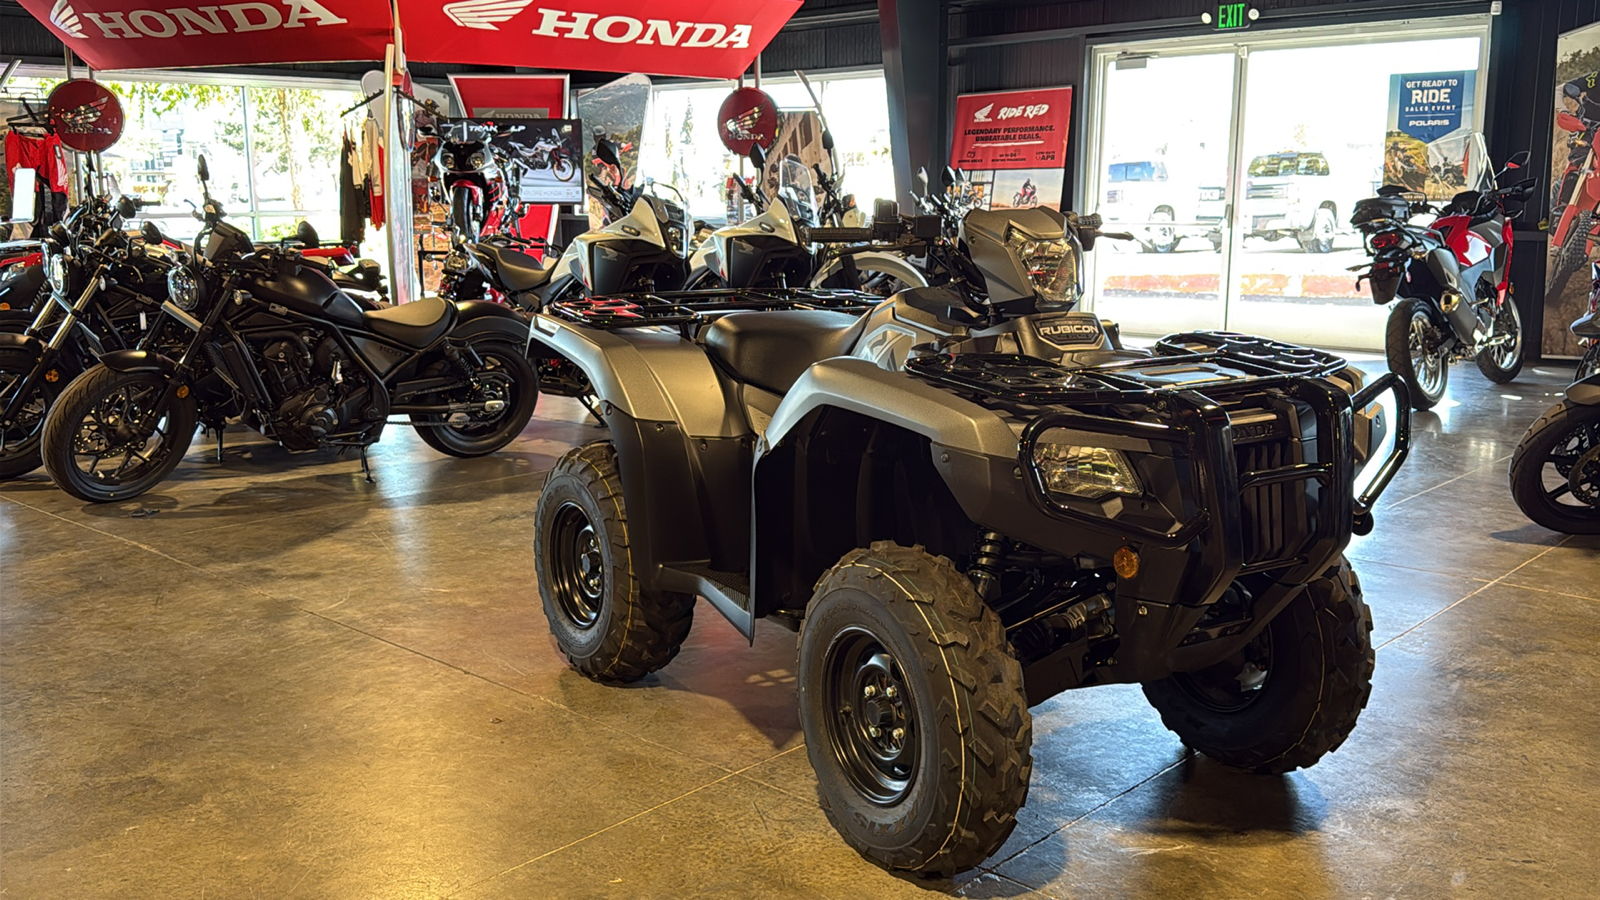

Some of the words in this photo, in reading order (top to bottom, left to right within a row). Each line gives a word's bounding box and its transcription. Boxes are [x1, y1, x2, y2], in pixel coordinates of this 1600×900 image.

[83, 0, 348, 39] HONDA
[1218, 3, 1245, 28] EXIT
[531, 7, 752, 48] HONDA
[1406, 80, 1421, 88] GET
[1422, 79, 1447, 88] READY
[1448, 78, 1458, 86] TO
[1411, 88, 1451, 104] RIDE
[997, 105, 1025, 120] RIDE
[1023, 103, 1050, 119] RED
[964, 127, 1002, 136] LEGENDARY
[1003, 125, 1056, 134] PERFORMANCE.
[975, 134, 1017, 142] UNBEATABLE
[1018, 132, 1042, 141] DEALS.
[1039, 325, 1099, 336] RUBICON
